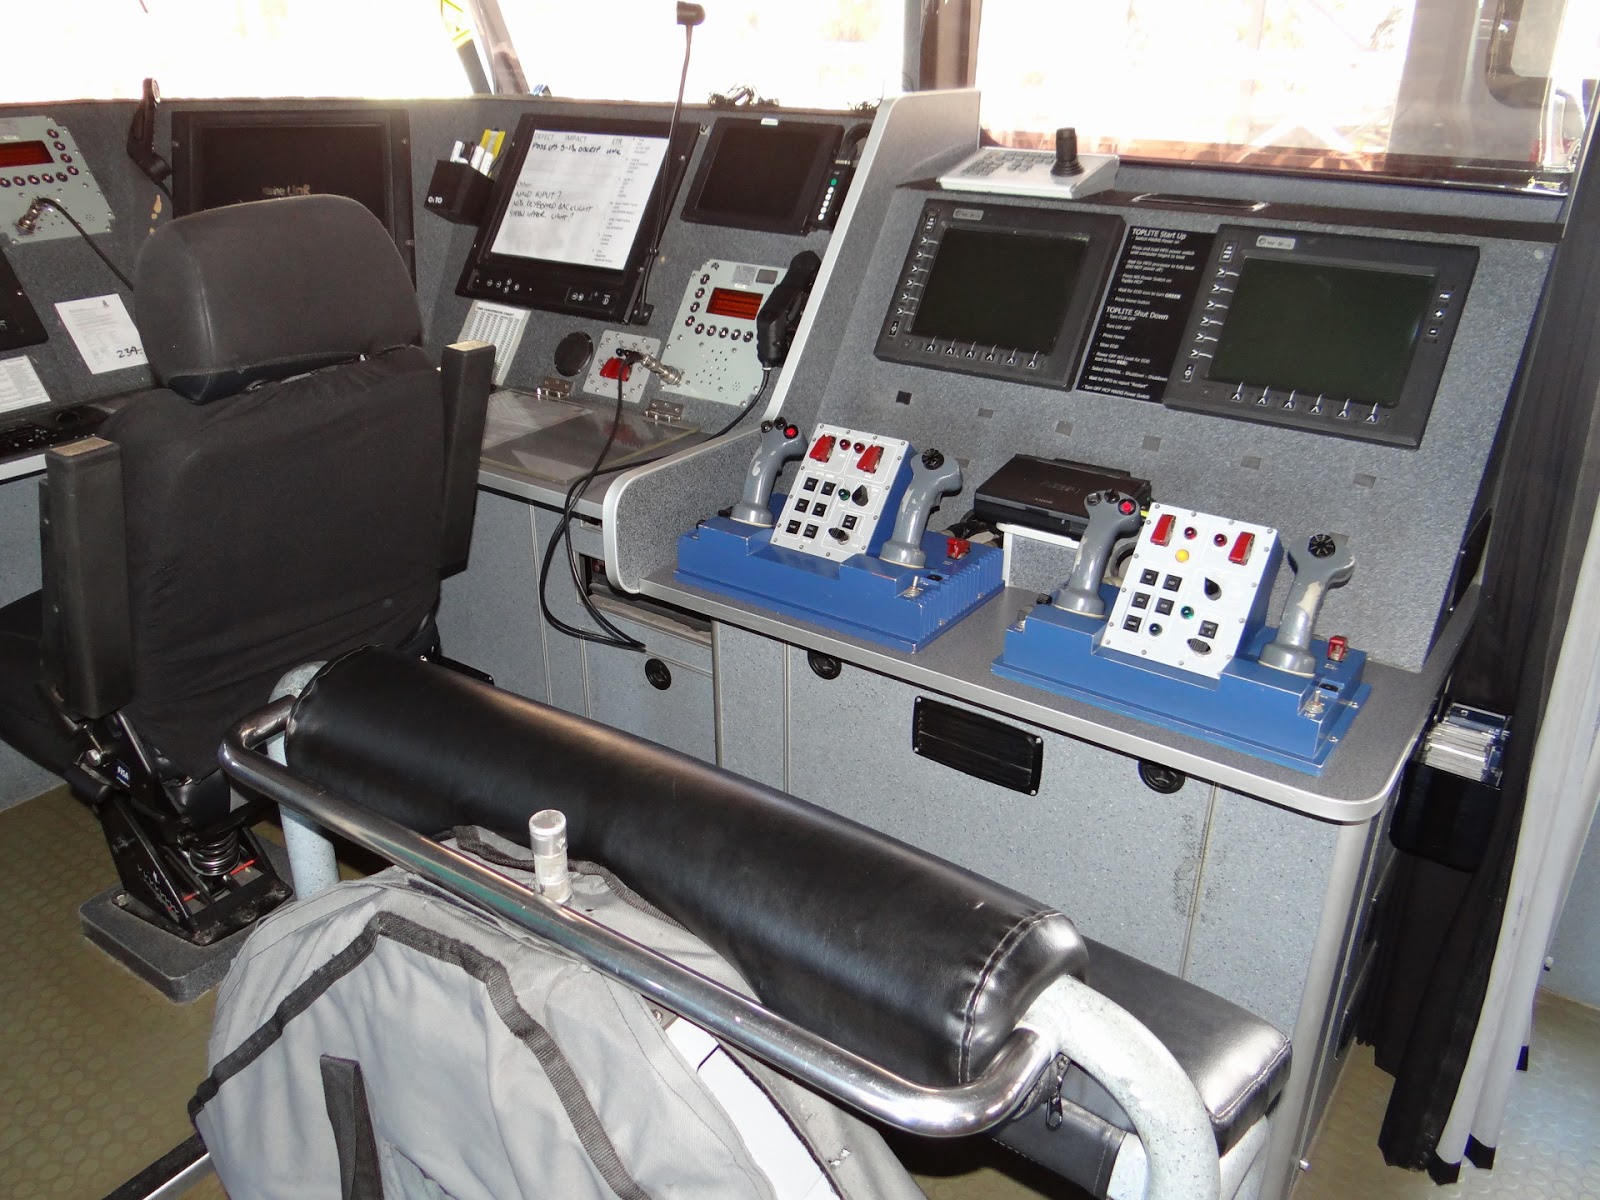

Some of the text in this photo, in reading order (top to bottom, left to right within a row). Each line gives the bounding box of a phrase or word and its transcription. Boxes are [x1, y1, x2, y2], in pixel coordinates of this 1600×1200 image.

[565, 134, 587, 142] IMPACT
[526, 201, 556, 210] KEYBOARD
[1132, 228, 1158, 238] TOPLITE
[1106, 306, 1169, 320] TOPLITE Shut Down
